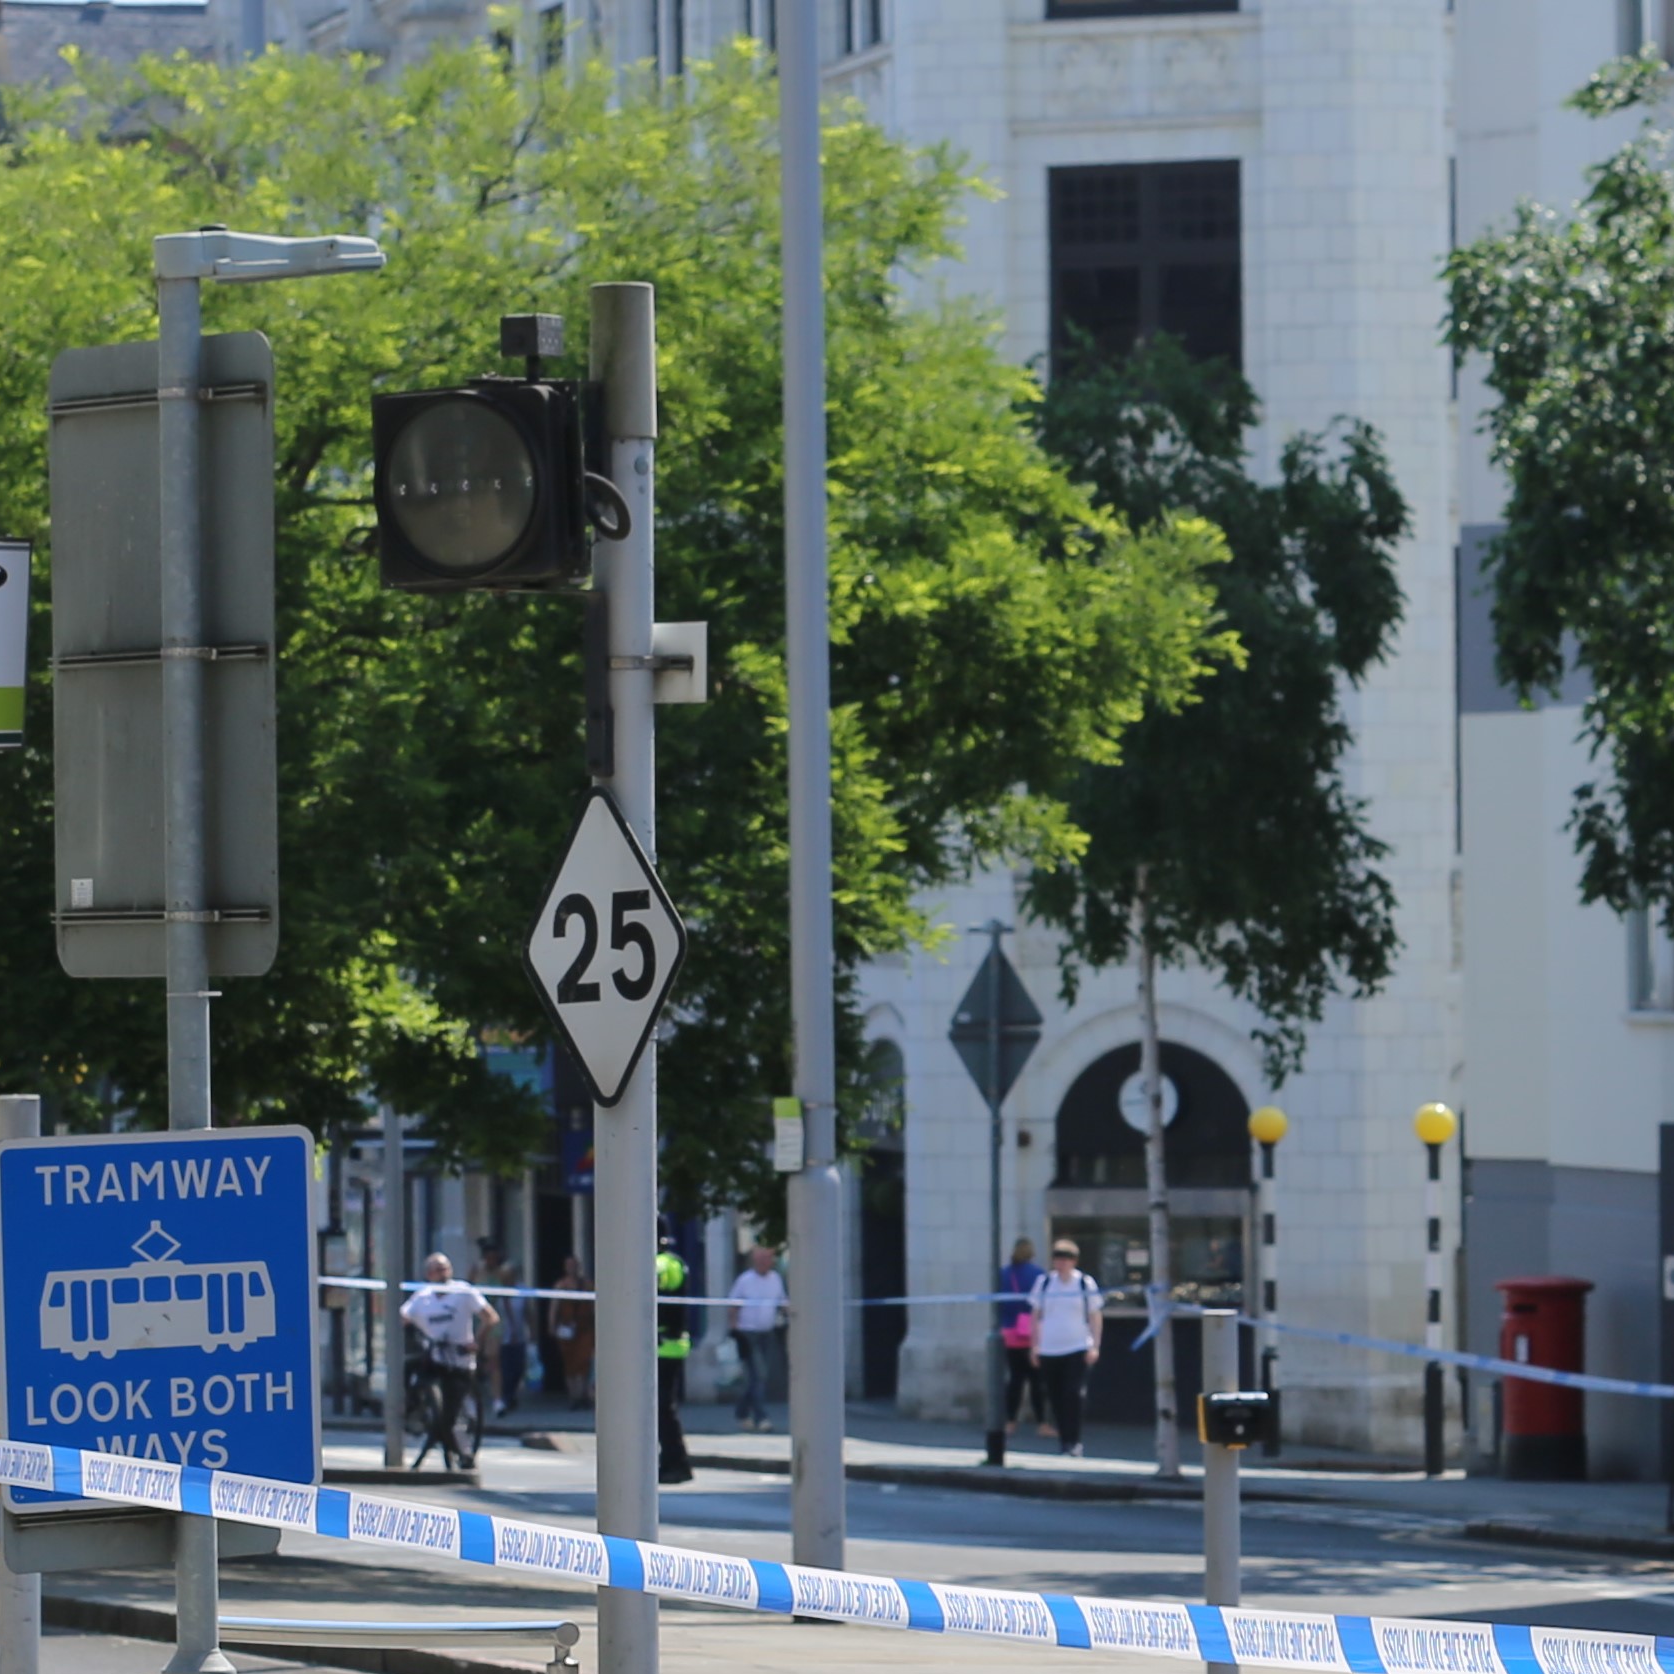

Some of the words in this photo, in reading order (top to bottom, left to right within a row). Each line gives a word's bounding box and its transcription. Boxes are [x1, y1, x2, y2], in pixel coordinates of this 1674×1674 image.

[552, 888, 657, 1005] 25
[34, 1155, 272, 1206] TRAMWAY
[25, 1378, 153, 1427] LOOK
[170, 1370, 295, 1418] BOTH
[216, 1480, 243, 1512] CROSS
[238, 1484, 258, 1515] NOT
[254, 1487, 270, 1517] DO
[266, 1488, 288, 1520] LINE
[282, 1490, 313, 1524] POLICE
[353, 1502, 383, 1537] CROSS
[378, 1506, 398, 1540] NOT
[395, 1509, 412, 1541] DO
[407, 1511, 429, 1545] LINE
[425, 1513, 456, 1550] POLICE
[499, 1527, 528, 1562] CROSS
[525, 1531, 545, 1566] NOT
[542, 1534, 558, 1568] DO
[555, 1536, 575, 1571] LINE
[574, 1540, 602, 1576] POLICE
[648, 1551, 676, 1588] CROSS
[674, 1556, 693, 1590] NOT
[692, 1558, 705, 1592] DO
[704, 1560, 723, 1595] LINE
[722, 1563, 751, 1600] POLICE
[798, 1574, 824, 1610] CROSS
[823, 1577, 841, 1613] NOT
[841, 1580, 854, 1614] DO
[853, 1581, 872, 1617] LINE
[871, 1583, 901, 1620] POLICE
[945, 1592, 973, 1629] CROSS
[971, 1595, 990, 1632] NOT
[988, 1597, 1003, 1633] DO
[1000, 1598, 1021, 1635] LINE
[1018, 1601, 1047, 1637] POLICE
[1090, 1606, 1118, 1644] CROSS
[1117, 1608, 1134, 1646] NOT
[1132, 1610, 1146, 1647] DO
[1143, 1611, 1164, 1648] LINE
[1161, 1611, 1190, 1651] POLICE
[1233, 1617, 1259, 1657] CROSS
[1260, 1618, 1277, 1659] NOT
[1276, 1620, 1290, 1660] DO
[1288, 1621, 1308, 1661] LINE
[1306, 1622, 1336, 1663] POLICE
[1383, 1628, 1412, 1668] CROSS
[1412, 1629, 1432, 1670] NOT
[1429, 1630, 1445, 1671] DO
[1442, 1631, 1465, 1672] LINE
[1462, 1632, 1496, 1674] POLICE
